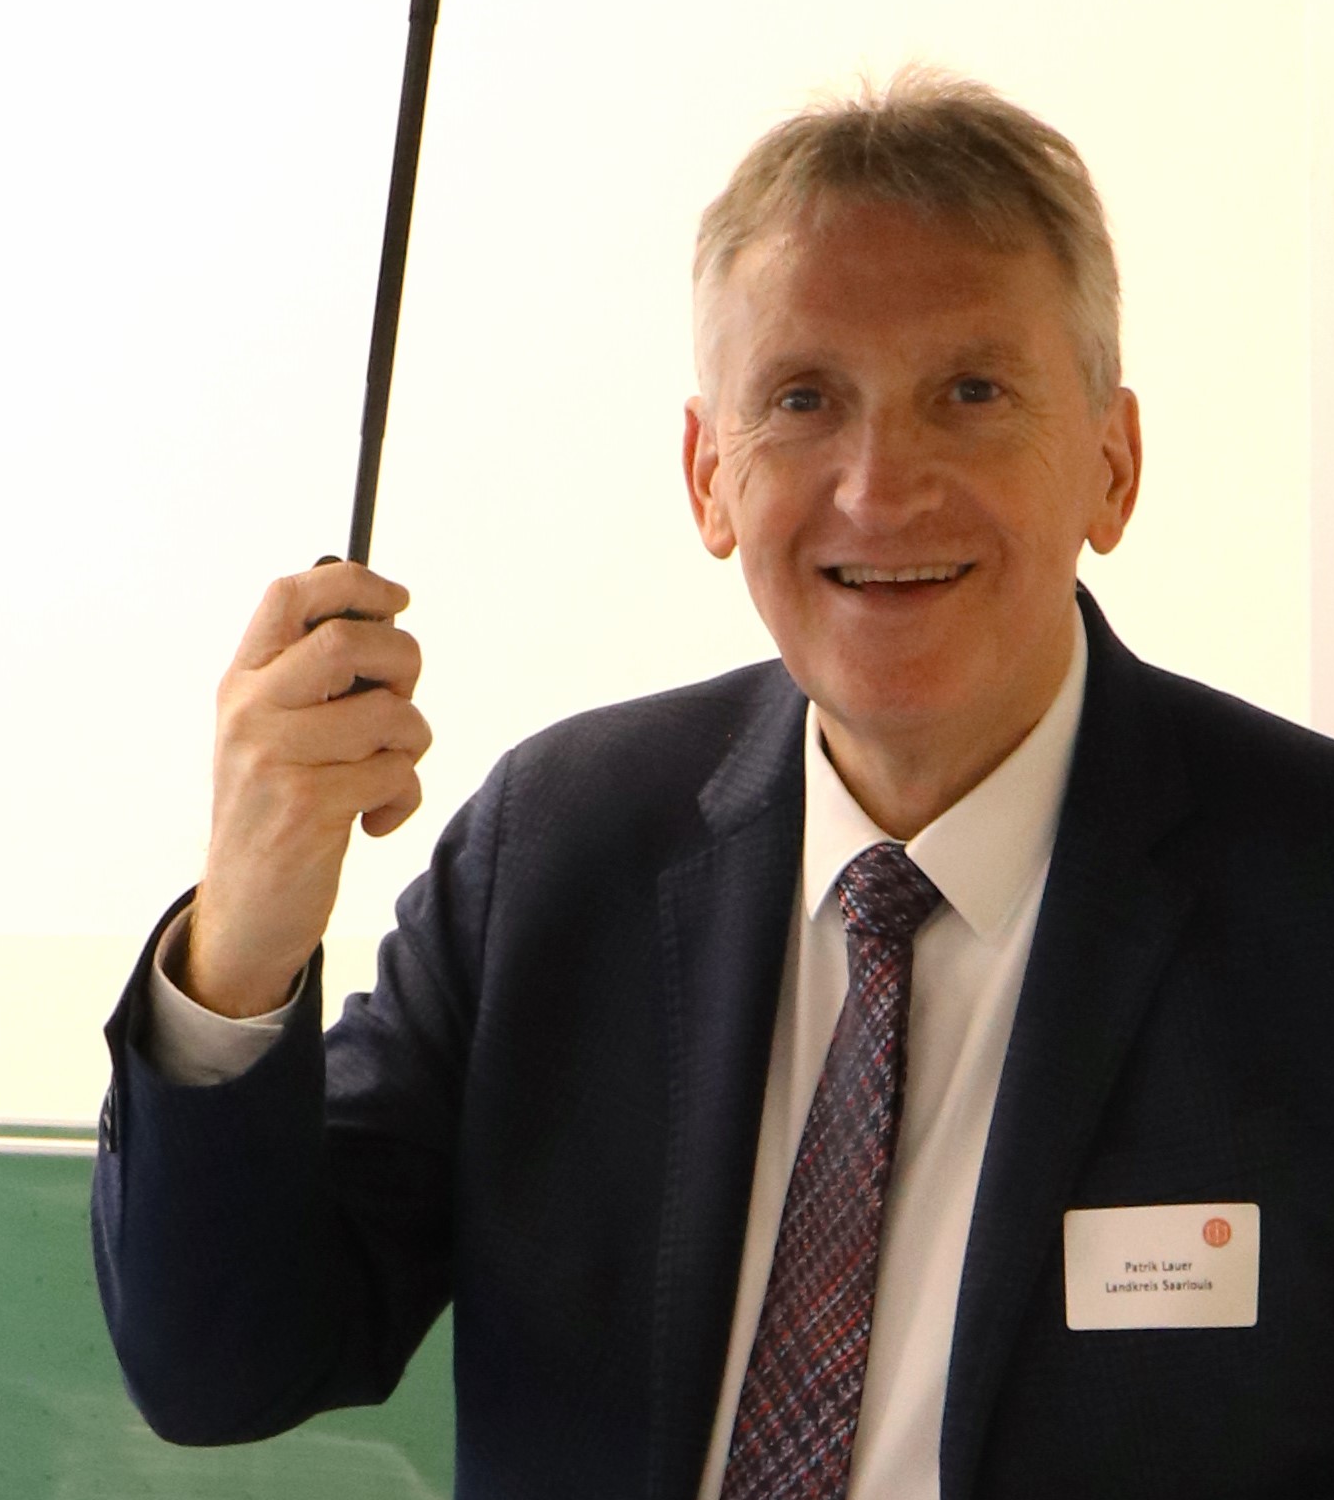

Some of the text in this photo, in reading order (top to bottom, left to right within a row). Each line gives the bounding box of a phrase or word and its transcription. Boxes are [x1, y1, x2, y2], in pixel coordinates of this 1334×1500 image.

[1124, 1260, 1193, 1274] Patrik Lauer
[1105, 1278, 1213, 1294] Landkreis Saarlouis
